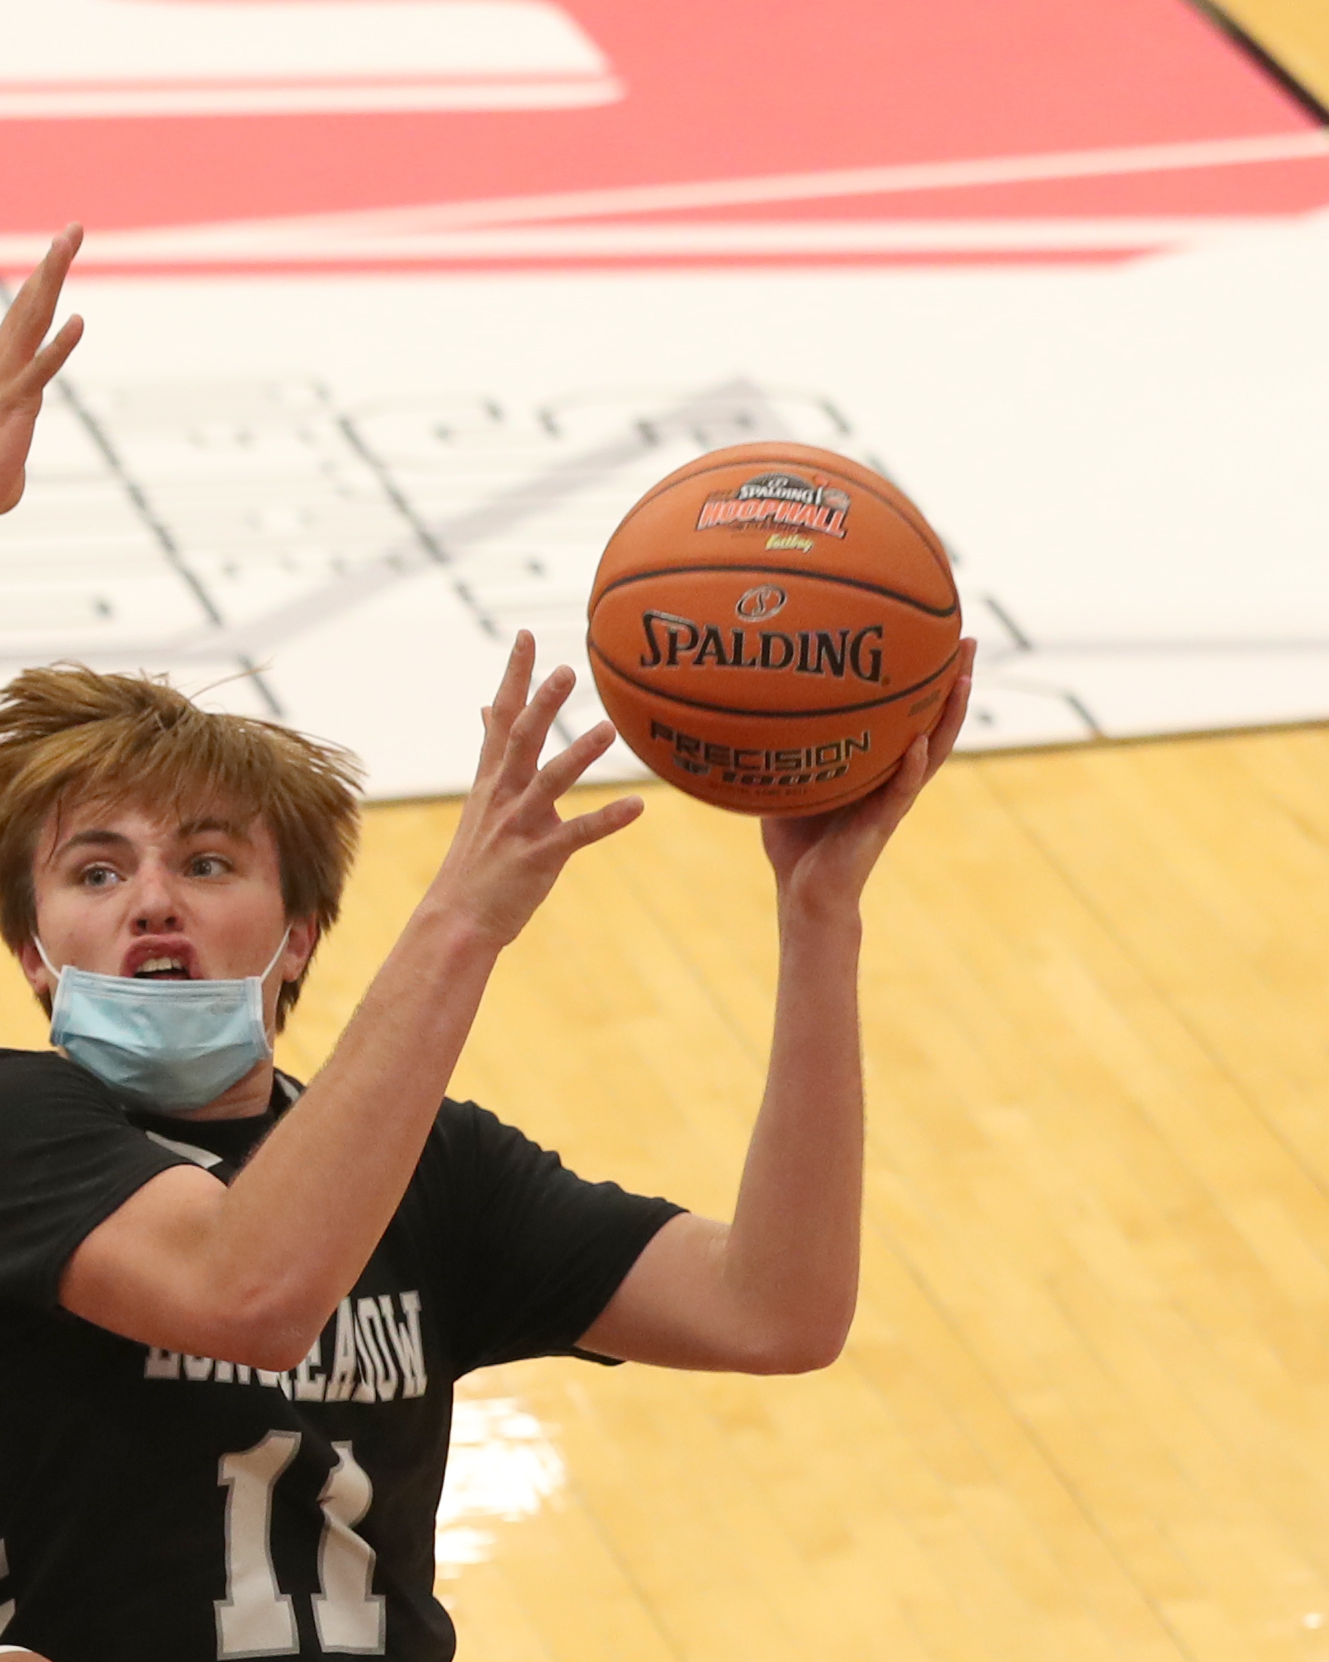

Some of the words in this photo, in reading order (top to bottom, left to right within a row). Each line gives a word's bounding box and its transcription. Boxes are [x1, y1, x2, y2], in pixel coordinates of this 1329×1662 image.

[696, 498, 847, 538] HOOPHALL
[740, 484, 815, 507] SPALDING
[639, 609, 885, 684] SPALDING
[650, 719, 871, 772] PRECISION
[213, 1429, 387, 1661] 11
